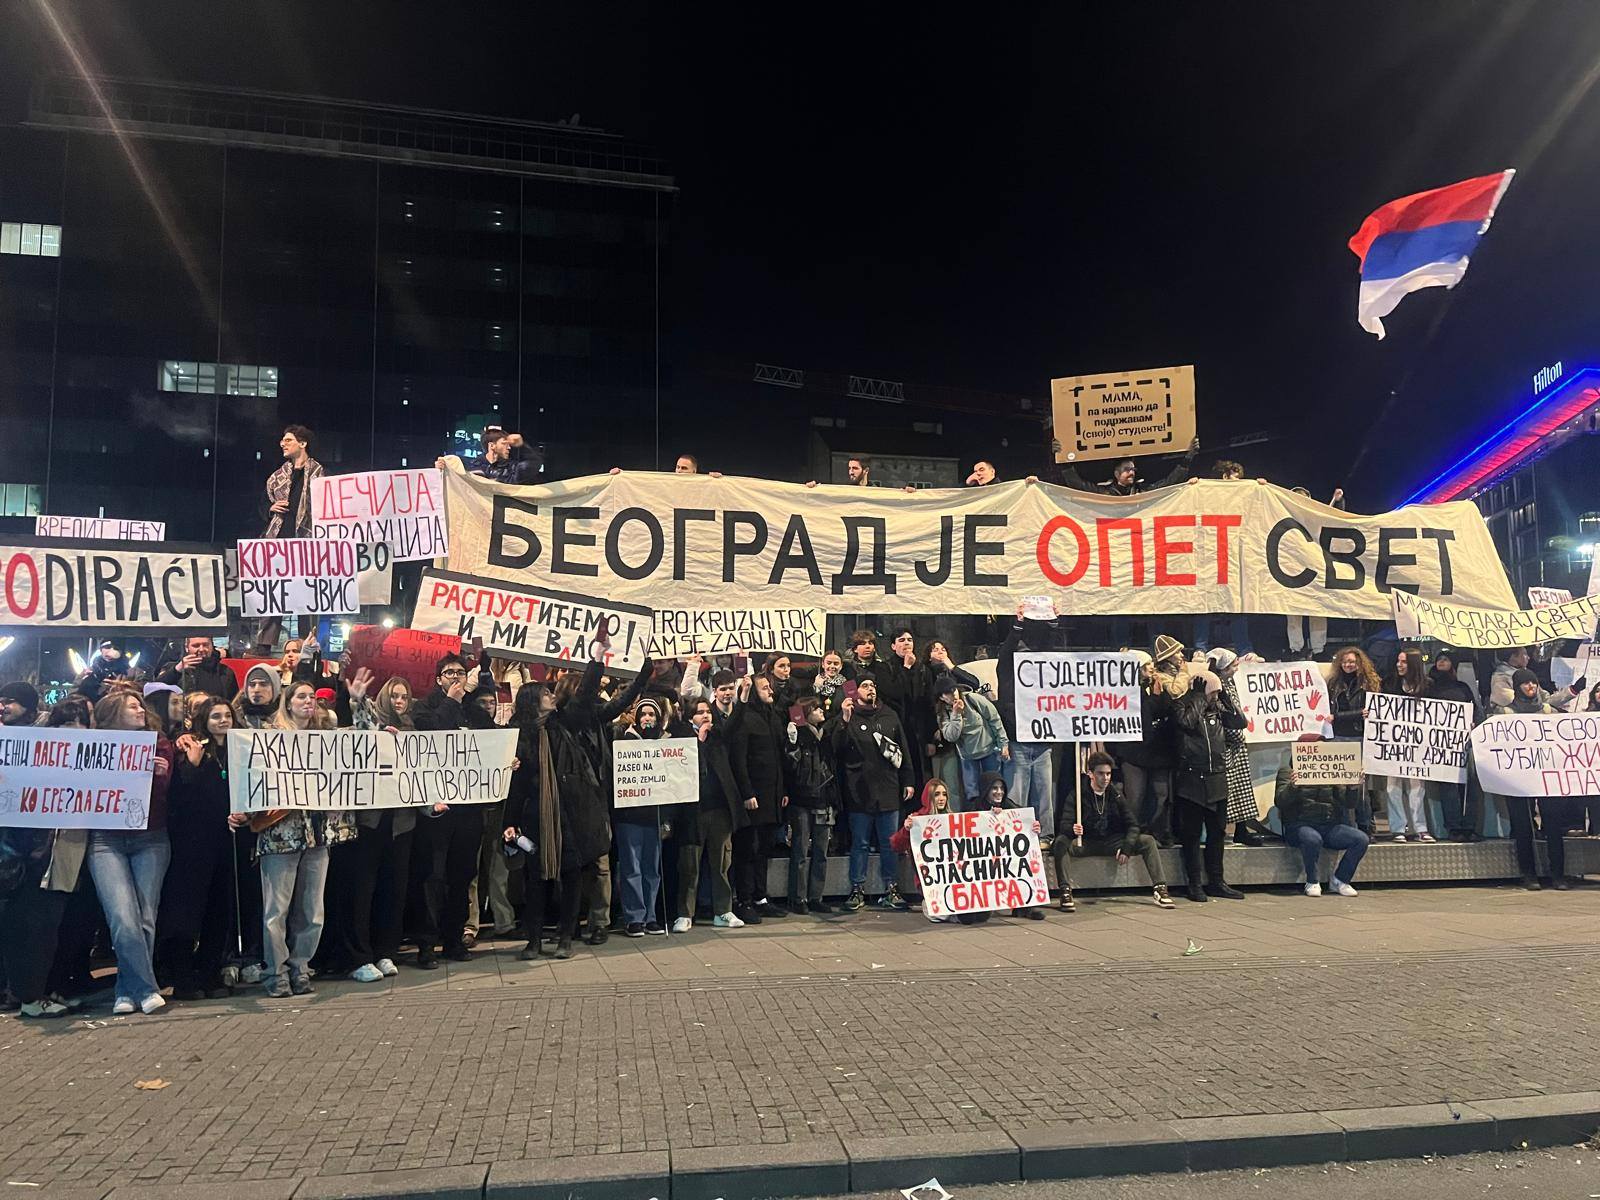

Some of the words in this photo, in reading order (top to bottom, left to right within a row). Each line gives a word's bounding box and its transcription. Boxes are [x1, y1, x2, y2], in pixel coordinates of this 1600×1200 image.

[1533, 361, 1563, 395] Hilton
[1088, 408, 1099, 416] па
[1102, 404, 1144, 416] наравно
[1145, 403, 1159, 412] да
[1102, 391, 1143, 403] МАМА,
[1082, 427, 1116, 441] (своје)
[1118, 423, 1166, 436] студенте!
[1094, 415, 1153, 427] подржавам
[319, 473, 435, 520] ДЕЧИЈА
[487, 494, 897, 595] БЕОГРАД
[914, 514, 1009, 588] ЈЕ
[1036, 514, 1242, 587] ОПЕТ
[1265, 517, 1455, 595] СВЕТ
[239, 540, 354, 579] КОРУПЦИЈО
[0, 552, 222, 621] ODIRAĆU
[240, 579, 293, 614] РУКЕ
[305, 578, 356, 612] УВИС
[430, 582, 620, 636] РАСПУСТИЋЕМО
[775, 609, 818, 632] TOK
[1457, 610, 1533, 629] СПАВАЈ
[1536, 594, 1599, 624] СВЕТЕ
[458, 614, 474, 640] И
[491, 620, 529, 649] МИ
[681, 634, 706, 655] SE
[710, 630, 777, 652] ZADNJI
[781, 630, 823, 656] ROK!
[1461, 627, 1527, 646] ТВОЈЕ
[1532, 616, 1591, 643] ДЕТЕ
[1017, 659, 1141, 689] СТУДЕНТСКИ
[1247, 669, 1314, 693] БЛОКАДА
[1037, 694, 1075, 712] ГЛАС
[1082, 693, 1128, 711] ЈАЧИ
[1257, 694, 1279, 715] АКО
[1284, 693, 1301, 711] НЕ
[1368, 694, 1466, 730] АРХИТЕКТУРА
[1031, 717, 1056, 739] ОД
[1072, 716, 1142, 737] БЕТОНА!!!
[1265, 714, 1304, 734] САДА?
[1368, 720, 1389, 742] ЈЕ
[1392, 724, 1423, 744] САМО
[1480, 720, 1527, 743] ЛАКО
[1532, 719, 1555, 742] ЈЕ
[1557, 717, 1600, 741] СВО
[31, 740, 72, 769] ДАБРЕ,
[74, 742, 116, 771] ДОЛАЗЕ
[248, 732, 378, 770] АКАДЕМСКИ
[394, 733, 482, 768] МОРАЛНА
[617, 750, 641, 759] DAVNO
[644, 750, 650, 758] TI
[652, 750, 660, 758] JE
[661, 748, 684, 757] VRAG
[1296, 745, 1318, 754] НАДЕ
[1296, 754, 1355, 762] ОБРАЗОВАНИХ
[1374, 743, 1418, 762] ЈЕДНОГ
[617, 763, 641, 772] ZASEO
[643, 763, 653, 771] NA
[1297, 771, 1340, 779] БОГАТСТВА
[1333, 763, 1345, 771] ОД
[248, 771, 378, 808] ИНТЕГРИТЕТ
[617, 777, 639, 785] PRAG,
[640, 775, 666, 784] ZEMLJO
[1542, 769, 1600, 795] ПЛА
[20, 787, 38, 812] КО
[949, 813, 980, 838] НЕ
[920, 833, 1030, 863] СЛУШАМО
[920, 858, 1033, 887] ВЛАСНИКА
[944, 879, 1033, 912] (БАГРА)
